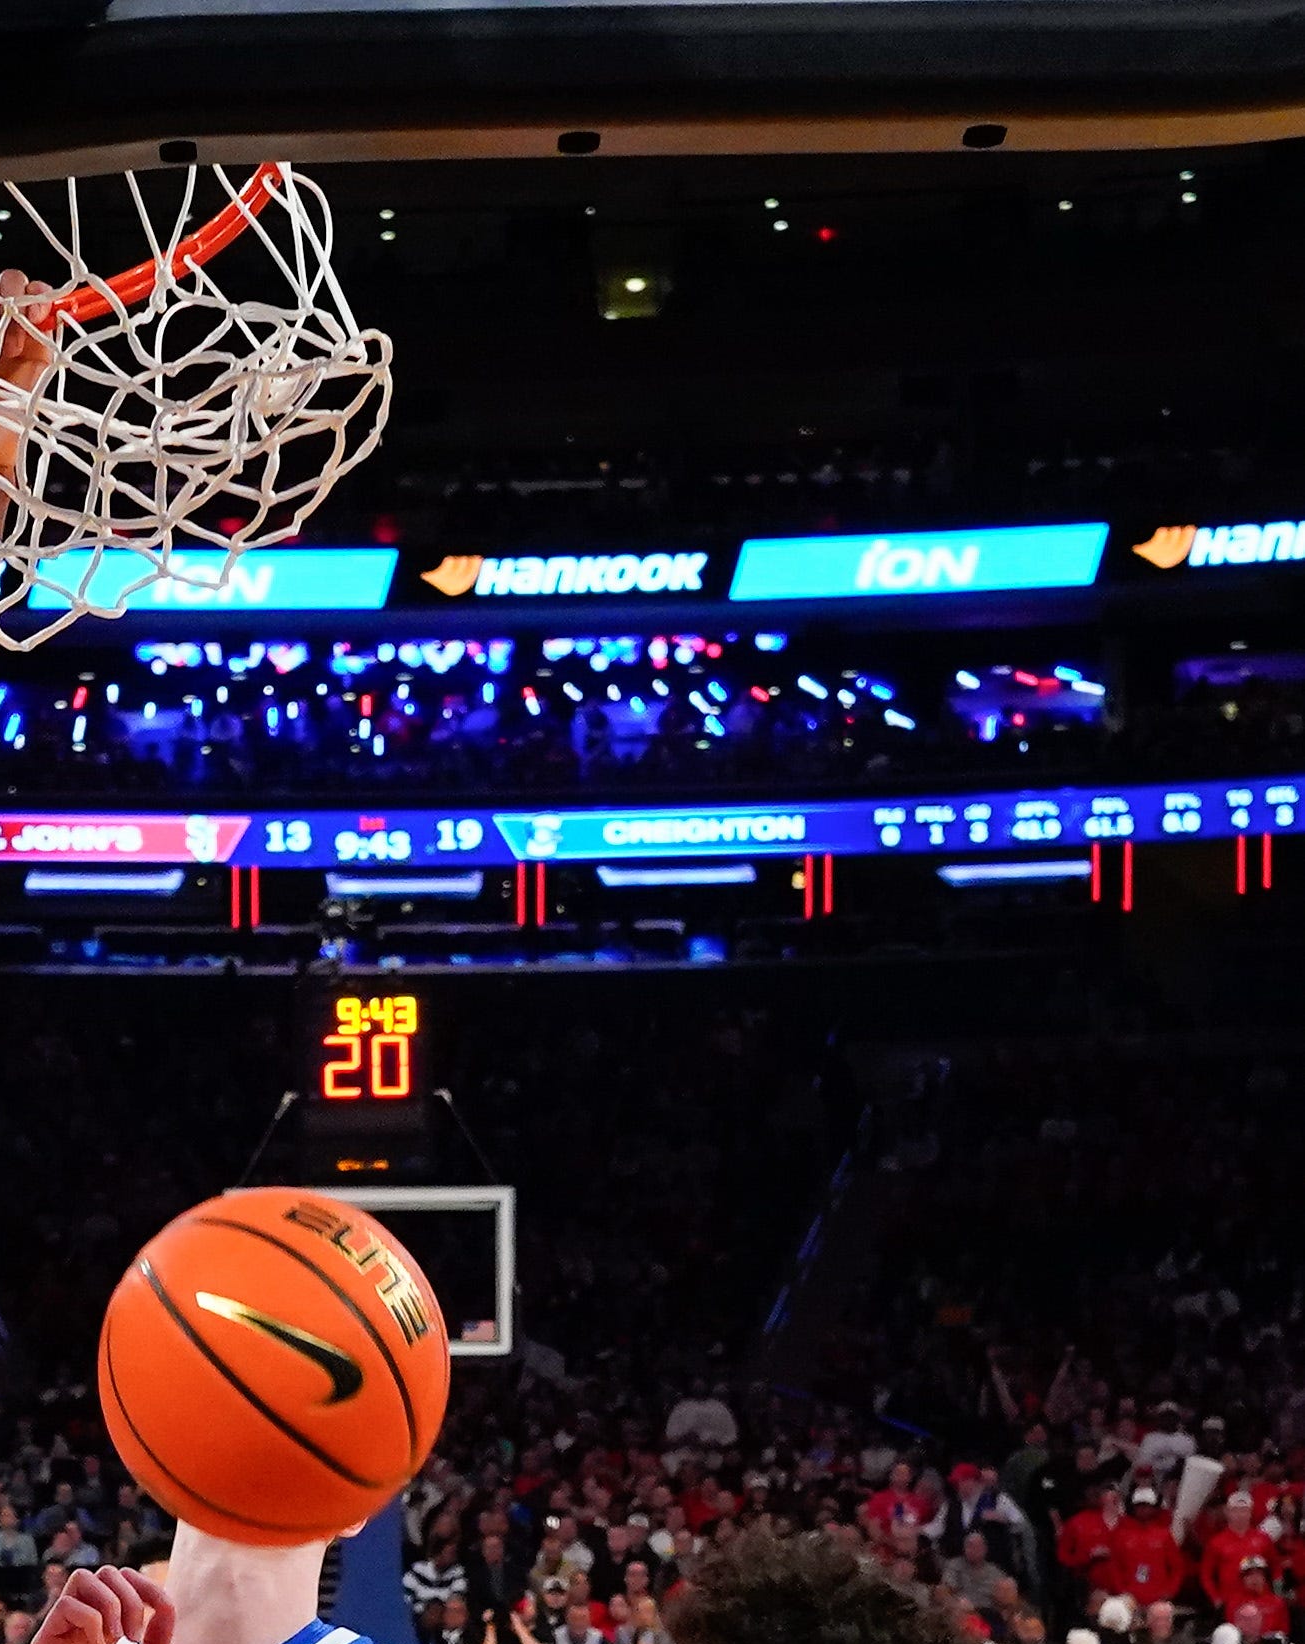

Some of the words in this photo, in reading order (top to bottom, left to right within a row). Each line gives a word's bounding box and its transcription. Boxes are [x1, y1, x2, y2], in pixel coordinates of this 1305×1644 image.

[265, 820, 312, 852] 13
[334, 831, 413, 861] 9:43
[436, 819, 484, 850] 19
[602, 814, 806, 846] CREIGHTON
[336, 996, 417, 1035] 9:43
[323, 1034, 410, 1098] 20
[282, 1201, 434, 1348] ELITE
